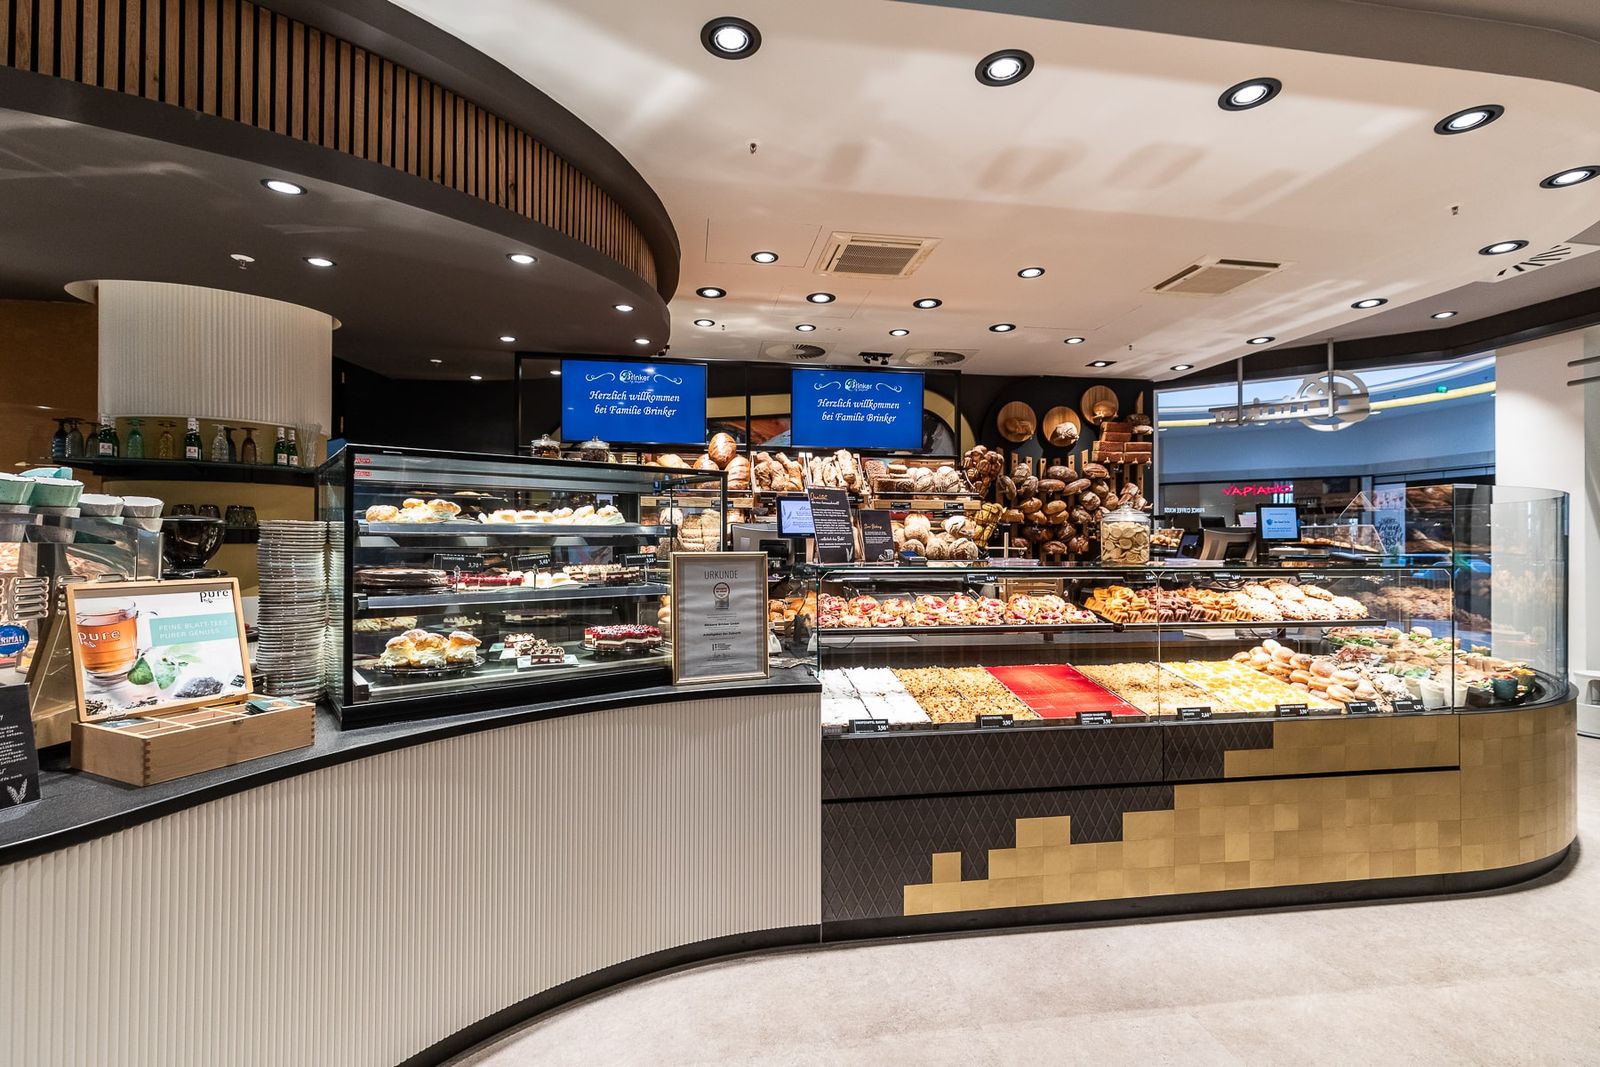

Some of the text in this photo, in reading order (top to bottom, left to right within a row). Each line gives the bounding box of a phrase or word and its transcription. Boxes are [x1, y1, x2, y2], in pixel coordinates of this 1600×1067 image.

[589, 391, 680, 403] Herzlich willkommen
[817, 398, 900, 410] Herzlich willkommen
[594, 404, 677, 417] bei Familie Brinker
[821, 411, 896, 424] bei Familie Brinker
[704, 570, 738, 580] URKUNDE
[200, 590, 229, 602] pure
[159, 623, 182, 631] FEINE
[78, 630, 120, 645] pure
[160, 628, 220, 639] PURER GENUSS
